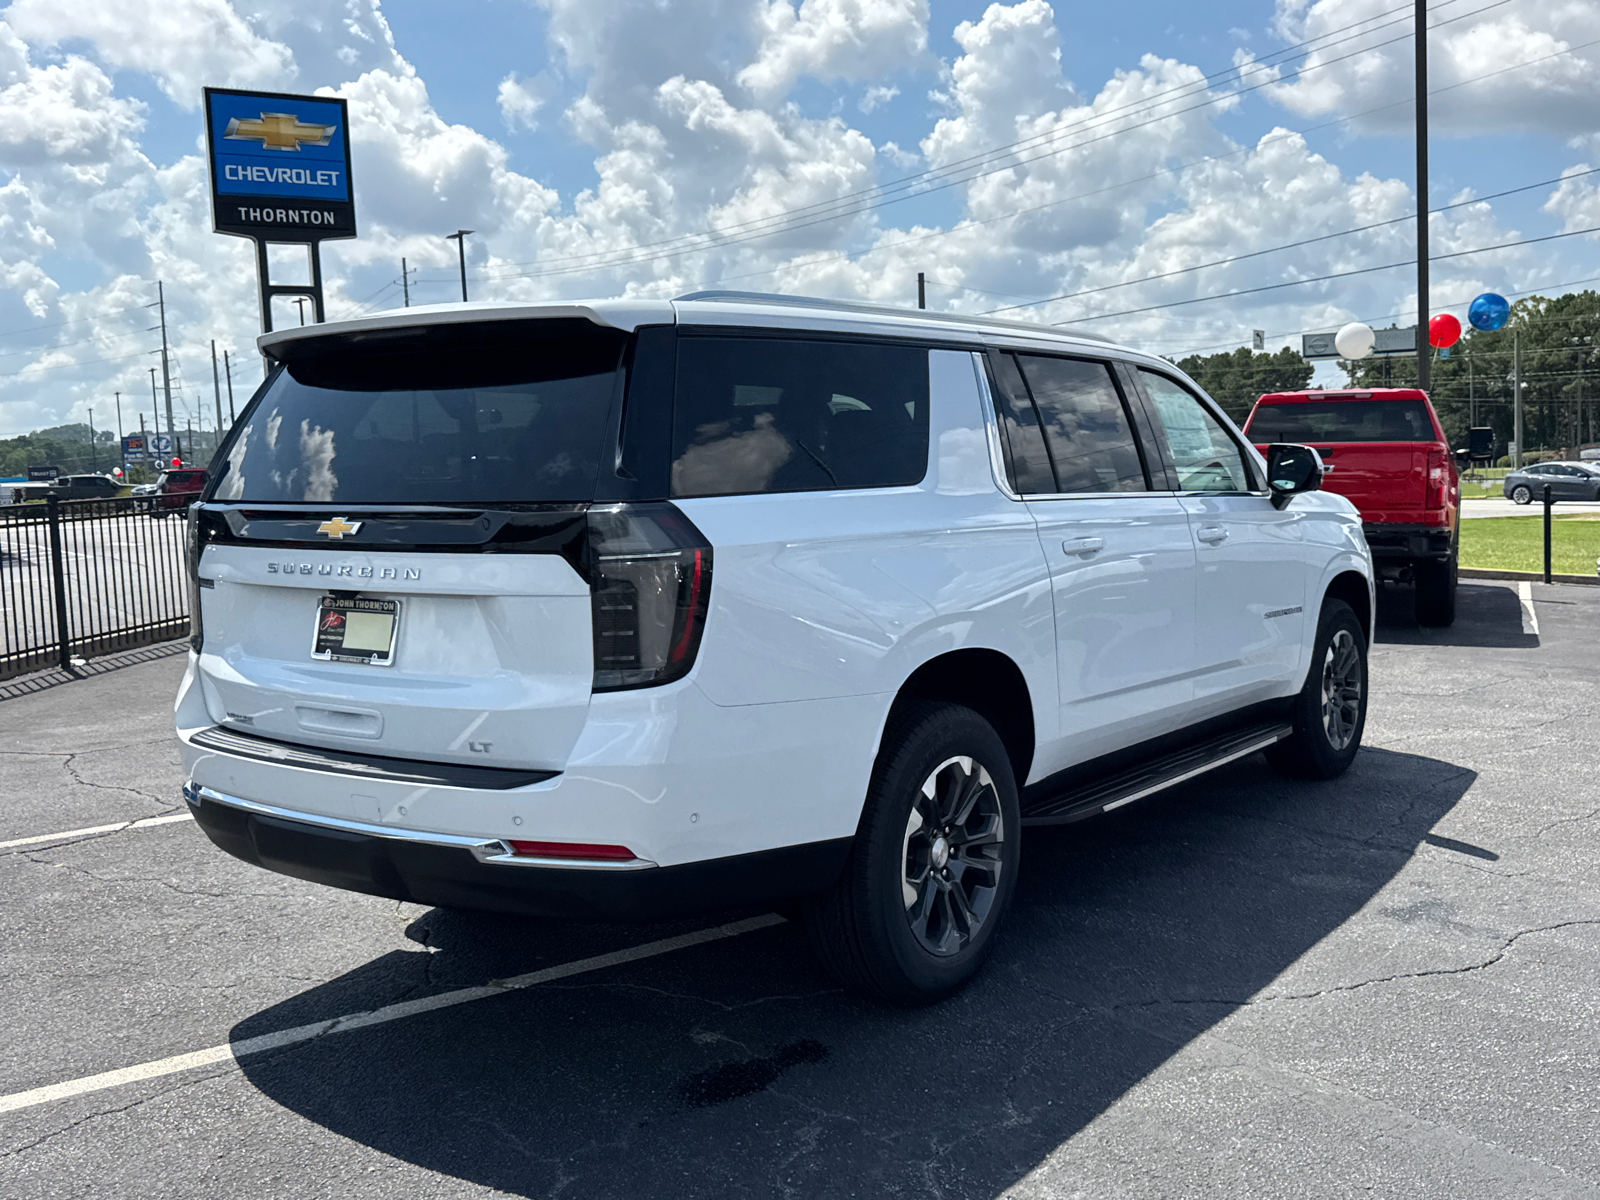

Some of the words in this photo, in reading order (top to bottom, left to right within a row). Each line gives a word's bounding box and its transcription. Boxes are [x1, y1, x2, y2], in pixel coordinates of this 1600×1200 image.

[225, 165, 339, 186] CHEVROLET
[238, 207, 335, 225] THORNTON
[267, 562, 421, 580] SUBURBAN
[335, 600, 354, 608] JOHN
[355, 600, 395, 610] THORNTON
[469, 741, 492, 753] LT
